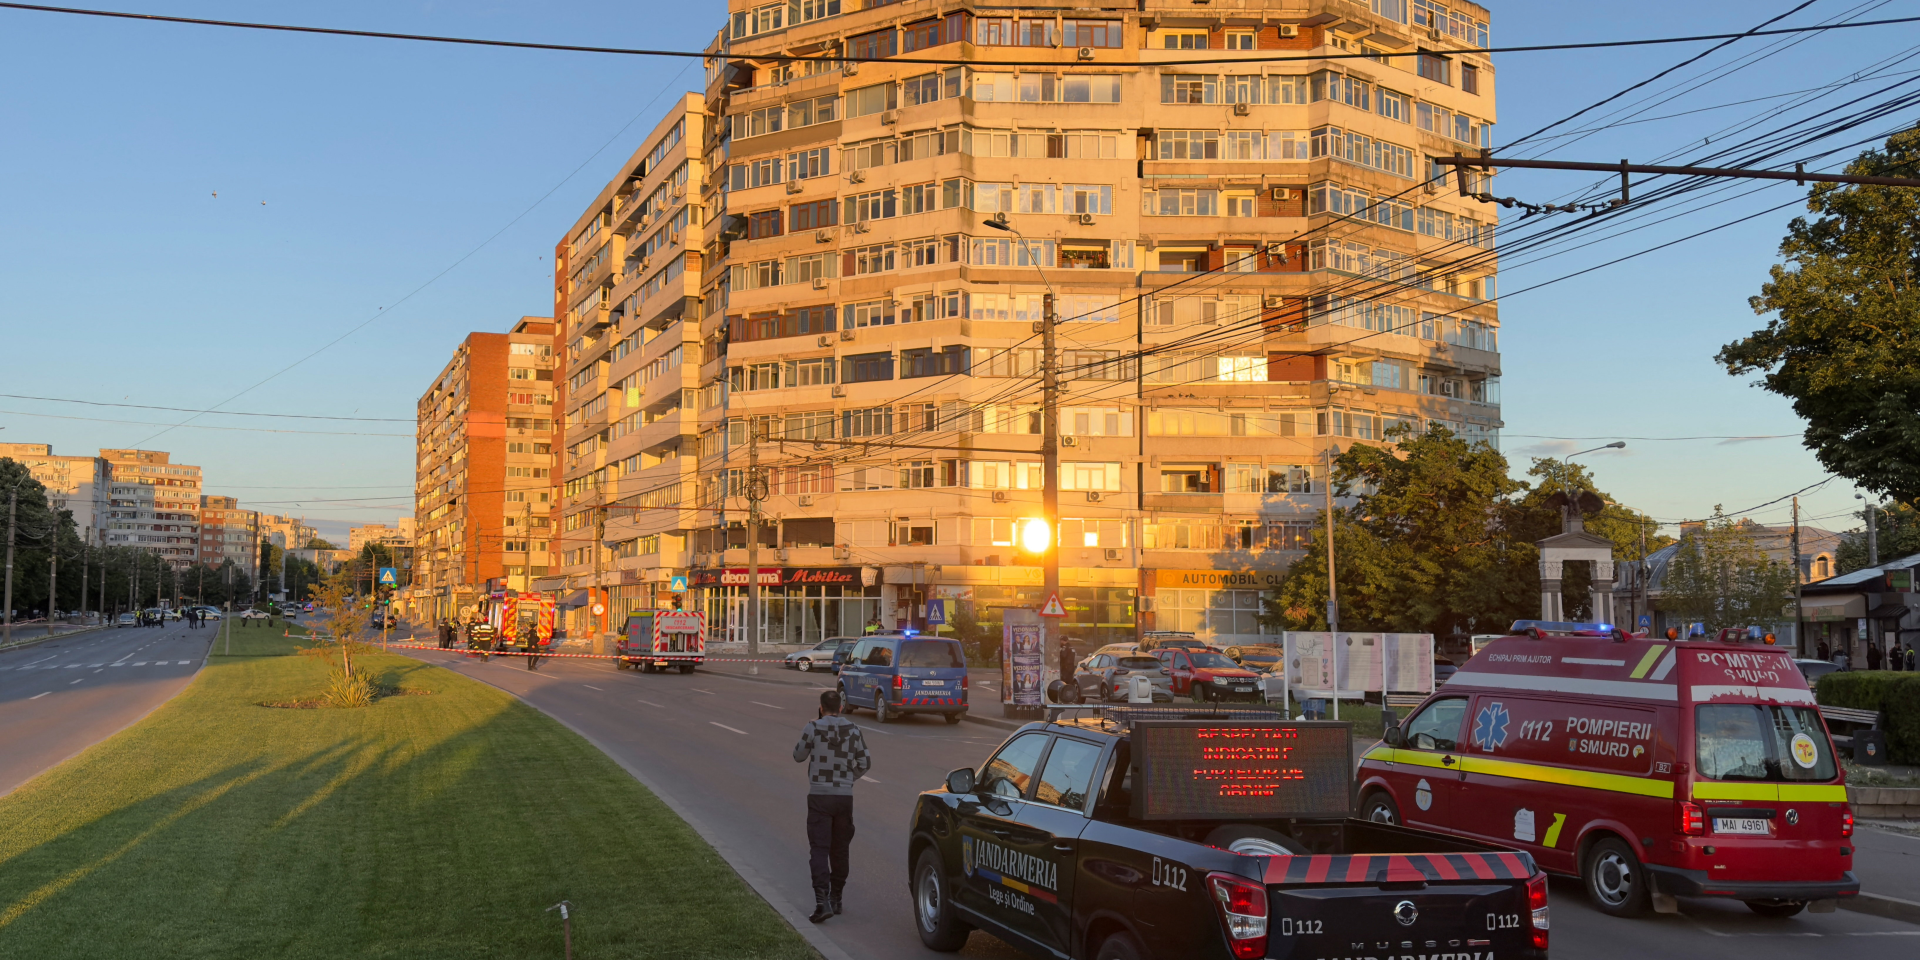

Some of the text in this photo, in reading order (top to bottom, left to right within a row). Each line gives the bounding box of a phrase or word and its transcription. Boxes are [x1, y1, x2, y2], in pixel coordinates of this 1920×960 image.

[721, 570, 779, 584] decoma
[784, 569, 853, 583] Mobilier
[1182, 573, 1258, 585] AUTOMOBIL
[1488, 653, 1552, 664] ECHIPAJ PRIM AJUTOR
[1526, 720, 1553, 742] 112
[1566, 716, 1652, 741] POMPIERII
[1579, 738, 1630, 758] SMURD
[1658, 763, 1668, 772] B2
[1721, 818, 1766, 831] MAI 49161
[974, 839, 1058, 892] JANDARMERIA
[1163, 864, 1188, 892] 112
[988, 883, 1035, 916] Lege și Ordine
[1296, 919, 1324, 935] 112
[1498, 914, 1520, 929] 112
[1351, 938, 1461, 950] MUSSO
